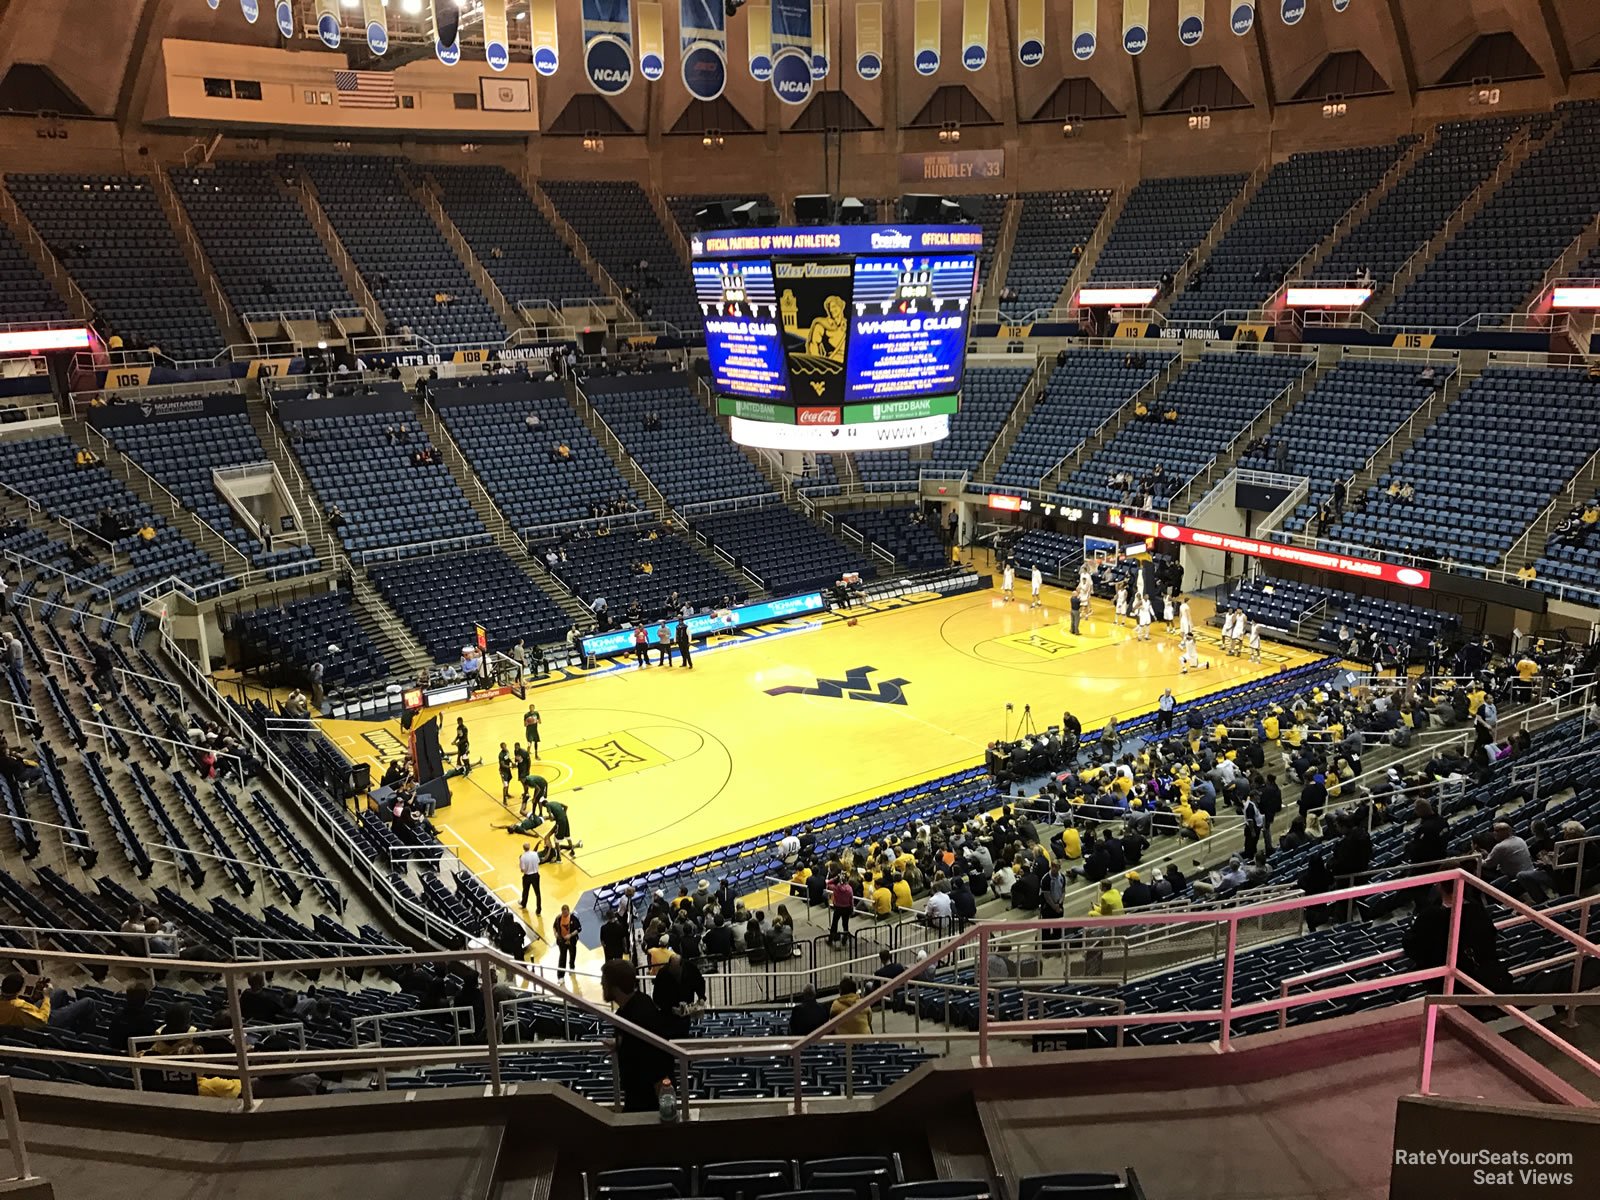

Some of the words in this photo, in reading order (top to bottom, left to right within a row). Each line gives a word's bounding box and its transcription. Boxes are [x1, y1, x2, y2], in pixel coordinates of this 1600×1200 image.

[1285, 8, 1303, 18] NCAA
[1234, 19, 1252, 29] NCAA
[1183, 30, 1202, 40] NCAA
[1076, 46, 1095, 54] NCAA
[1127, 40, 1146, 49] NCAA
[966, 57, 985, 66] NCAA
[1023, 53, 1042, 61] NCAA
[538, 62, 556, 70] NCAA
[645, 67, 661, 75] NCAA
[861, 67, 879, 75] NCAA
[919, 62, 937, 70] NCAA
[594, 68, 630, 83] NCAA
[779, 80, 810, 93] NCAA
[1323, 104, 1347, 119] 219
[1189, 115, 1211, 129] 218
[924, 163, 973, 179] HUNDLEY
[987, 162, 1000, 176] 33
[706, 238, 729, 252] OFFICIAL
[729, 236, 760, 250] PARTNER
[761, 235, 771, 249] OF
[772, 235, 793, 249] WVU
[794, 234, 840, 248] ATHLETICS
[922, 232, 950, 246] OFFICIAL
[857, 318, 921, 335] WHEELS
[923, 316, 962, 330] CLUB
[1008, 327, 1021, 337] 112
[1126, 327, 1138, 338] 113
[1160, 328, 1182, 338] WEST
[1184, 328, 1220, 340] VIRGINIA
[1405, 335, 1421, 348] 115
[396, 354, 424, 367] LET'S
[427, 353, 441, 365] GO
[463, 352, 481, 363] 108
[116, 374, 139, 387] 106
[740, 401, 760, 413] UNITED
[761, 403, 775, 414] BANK
[880, 401, 909, 414] UNITED
[910, 399, 931, 411] BANK
[1192, 532, 1223, 546] GREAT
[1259, 544, 1271, 555] IN
[1272, 547, 1339, 568] CONVENIENT
[1339, 560, 1382, 576] PLACES
[1037, 1041, 1068, 1052] 125
